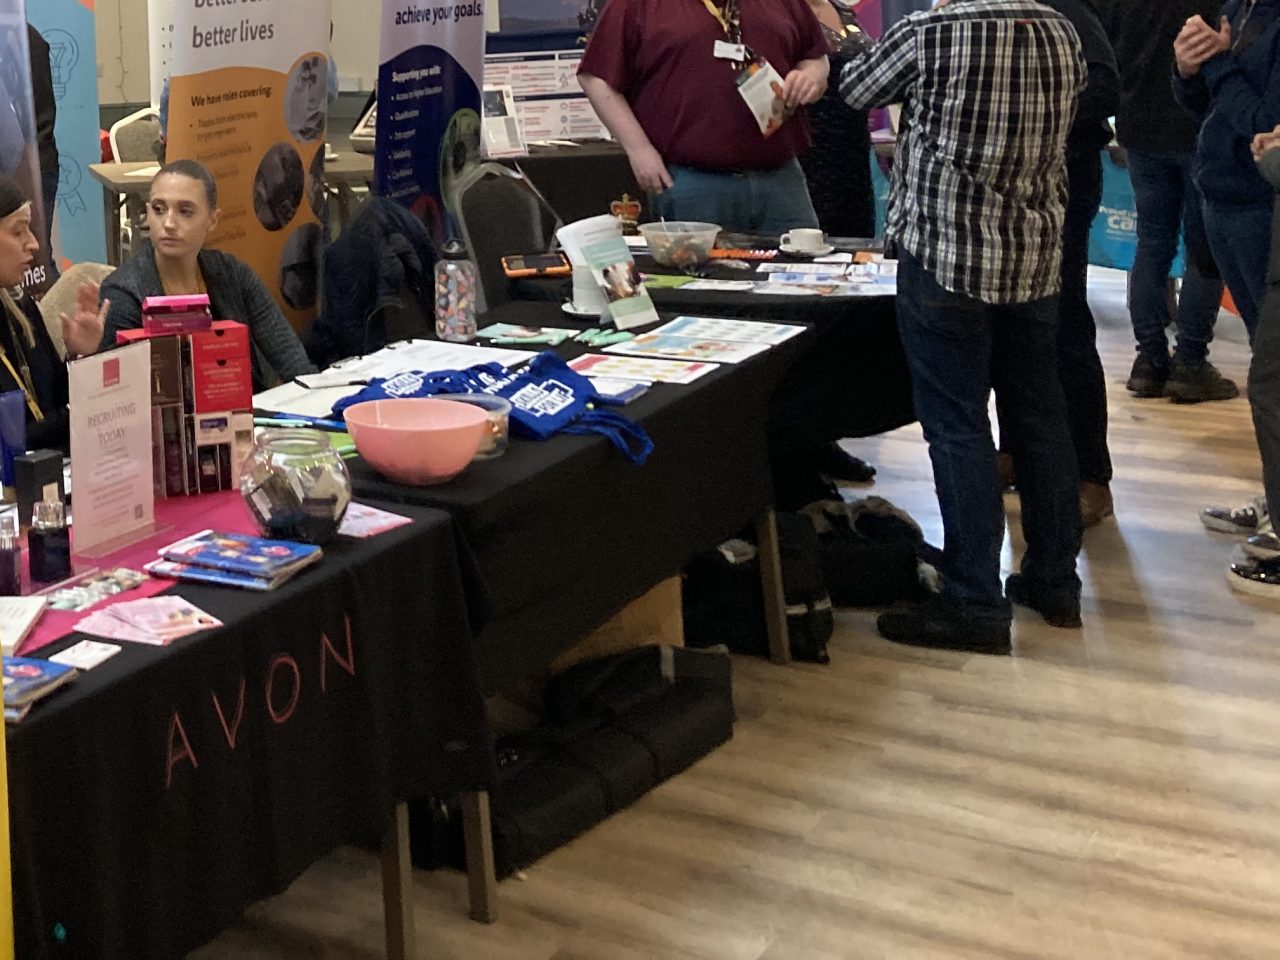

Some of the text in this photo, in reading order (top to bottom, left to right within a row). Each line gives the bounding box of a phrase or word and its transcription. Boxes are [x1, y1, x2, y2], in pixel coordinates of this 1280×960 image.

[395, 0, 484, 28] achieve your goals.
[192, 18, 274, 49] better lives
[190, 94, 205, 108] We
[206, 92, 221, 104] have
[1107, 214, 1137, 230] ca
[87, 401, 137, 429] RECRUITING
[97, 425, 127, 445] TODAY
[165, 615, 356, 790] AVON
